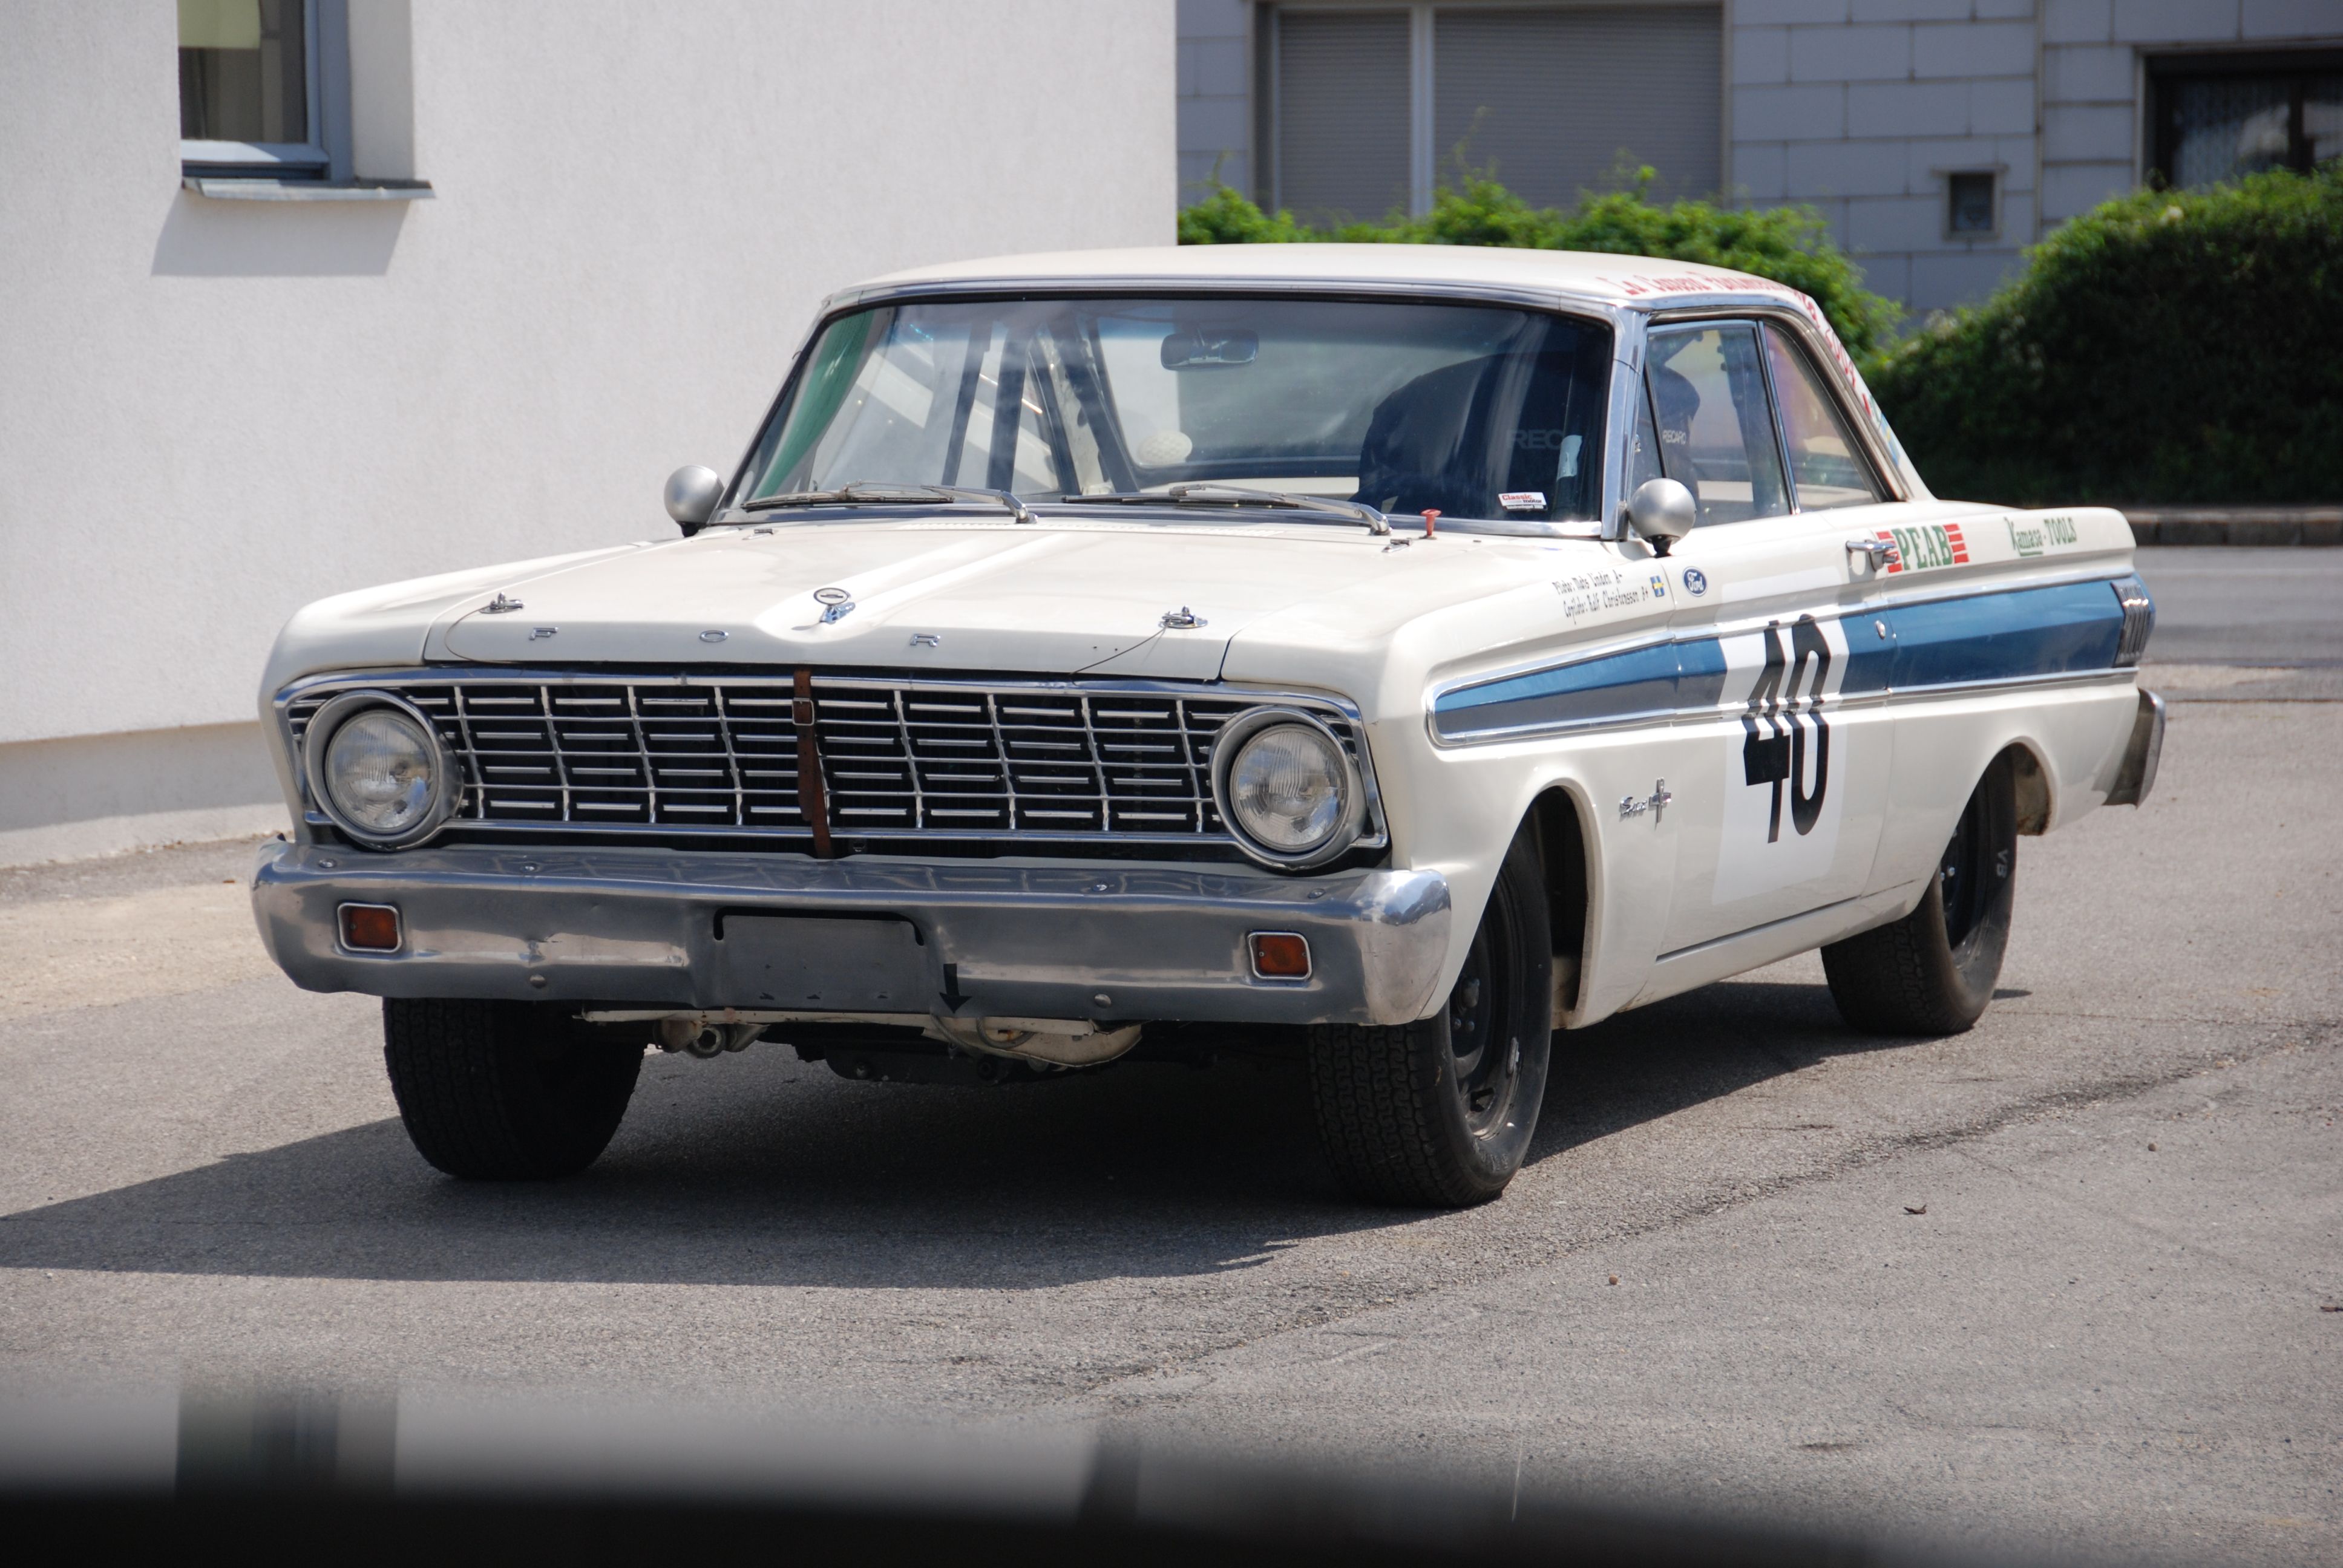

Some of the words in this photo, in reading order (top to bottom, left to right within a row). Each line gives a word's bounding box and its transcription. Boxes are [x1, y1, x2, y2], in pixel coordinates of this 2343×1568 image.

[1662, 430, 1687, 445] RECARO
[2044, 517, 2077, 546] TOOLS
[1891, 524, 1954, 570] PEAB
[1688, 571, 1704, 592] Ford
[1742, 613, 1831, 844] 40
